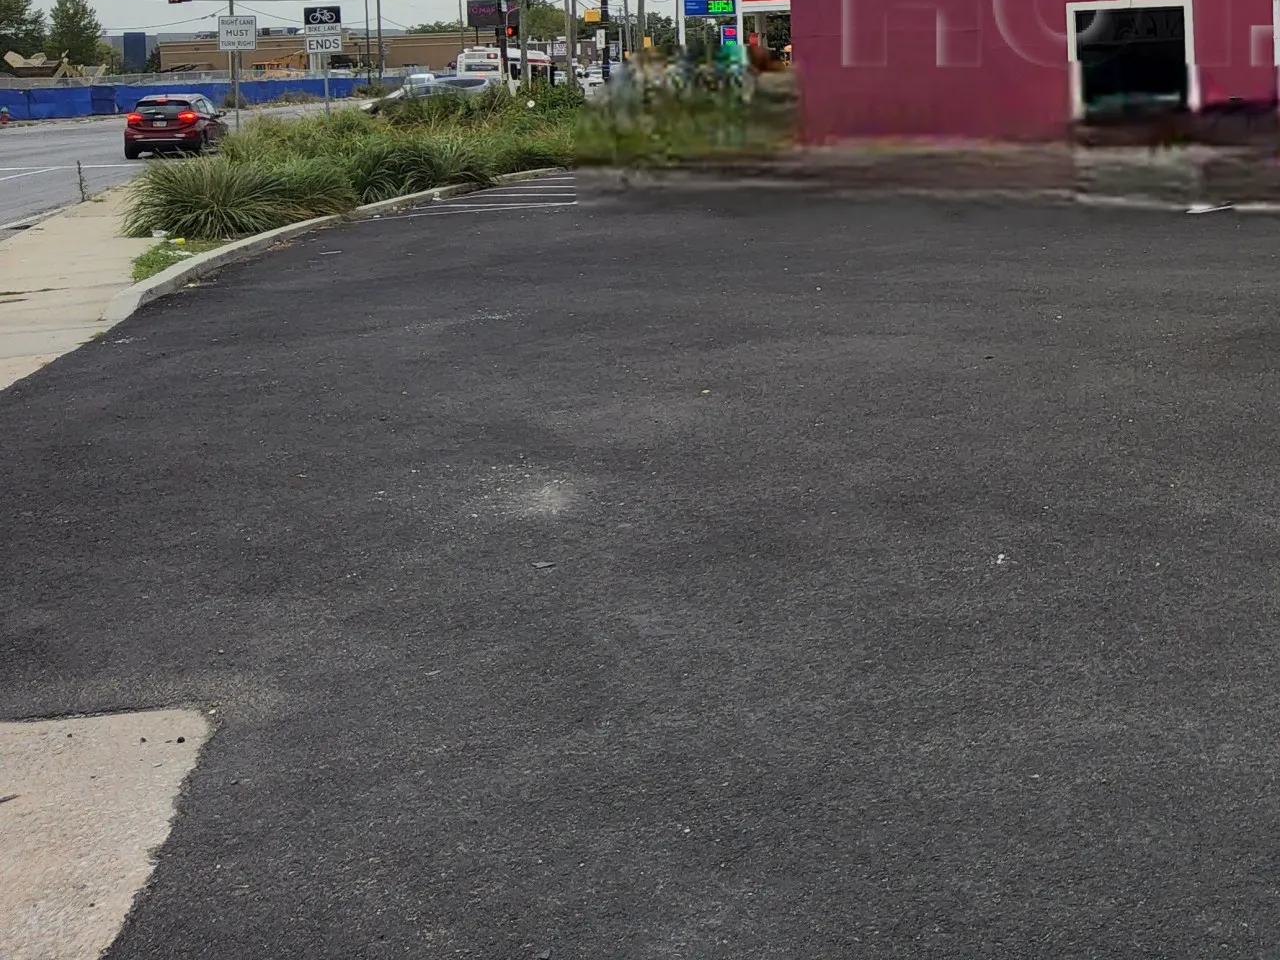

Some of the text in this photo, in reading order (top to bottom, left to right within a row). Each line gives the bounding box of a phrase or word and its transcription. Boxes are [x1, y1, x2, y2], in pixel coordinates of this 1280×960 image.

[323, 24, 338, 32] LANE
[225, 29, 249, 37] MUST
[308, 38, 340, 51] ENDS
